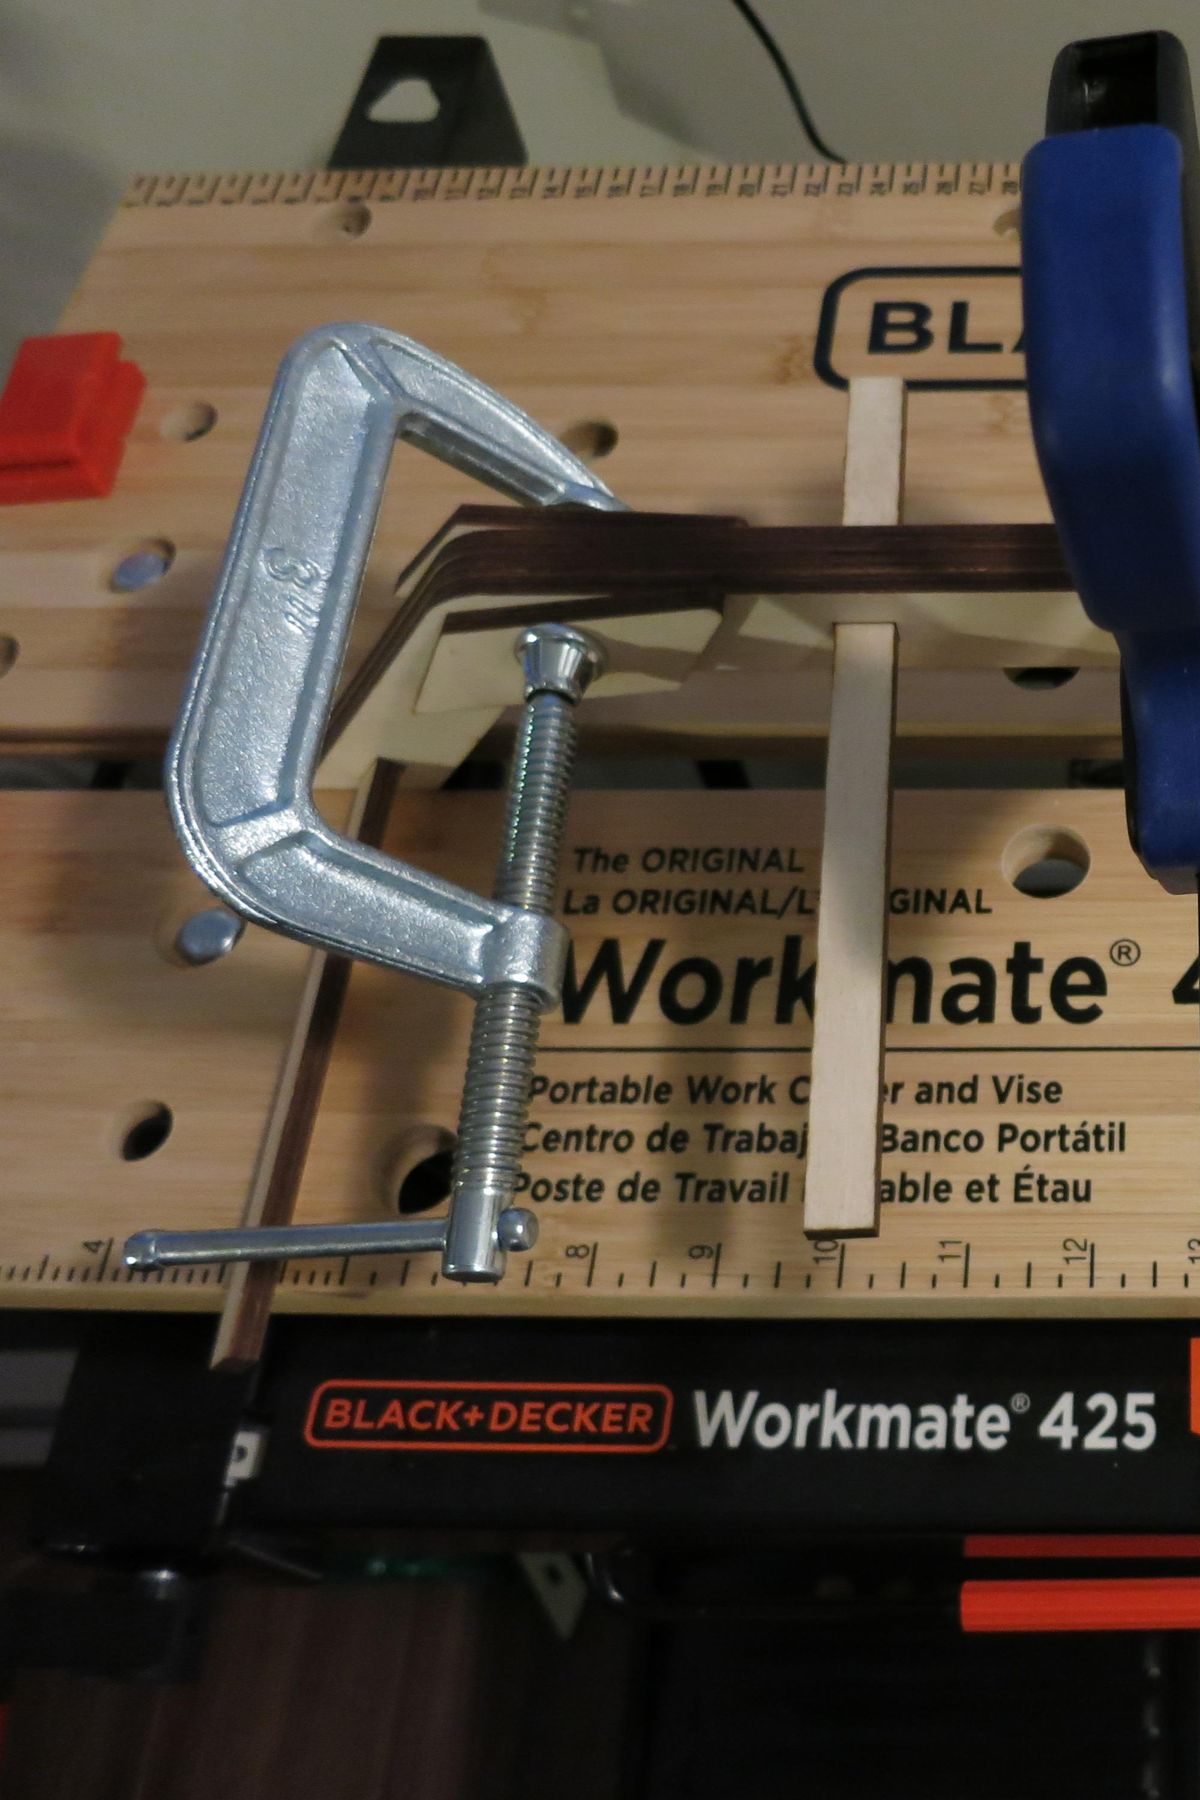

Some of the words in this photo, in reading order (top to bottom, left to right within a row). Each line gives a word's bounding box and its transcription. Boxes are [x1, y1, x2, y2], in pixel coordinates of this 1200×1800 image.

[573, 848, 630, 873] The
[641, 847, 804, 873] ORIGINAL
[562, 889, 600, 915] La
[528, 1074, 672, 1104] Portable
[686, 1074, 776, 1104] Work
[914, 1074, 979, 1104] and
[991, 1074, 1063, 1104] Vise
[521, 1122, 635, 1153] Centro
[646, 1121, 690, 1153] de
[703, 1122, 808, 1159] Trabaj
[881, 1123, 984, 1153] Banco
[998, 1120, 1126, 1153] Portátil
[617, 1171, 661, 1202] de
[675, 1171, 790, 1203] Travail
[965, 1173, 1000, 1203] et
[1012, 1164, 1092, 1203] Étau
[82, 1240, 104, 1254] 4
[565, 1244, 590, 1259] 8
[688, 1243, 714, 1260] 9
[813, 1238, 838, 1264] 10
[938, 1240, 962, 1263] 11
[1063, 1237, 1088, 1265] 12
[324, 1398, 654, 1433] BLACK+DECKER
[1038, 1391, 1157, 1450] 425
